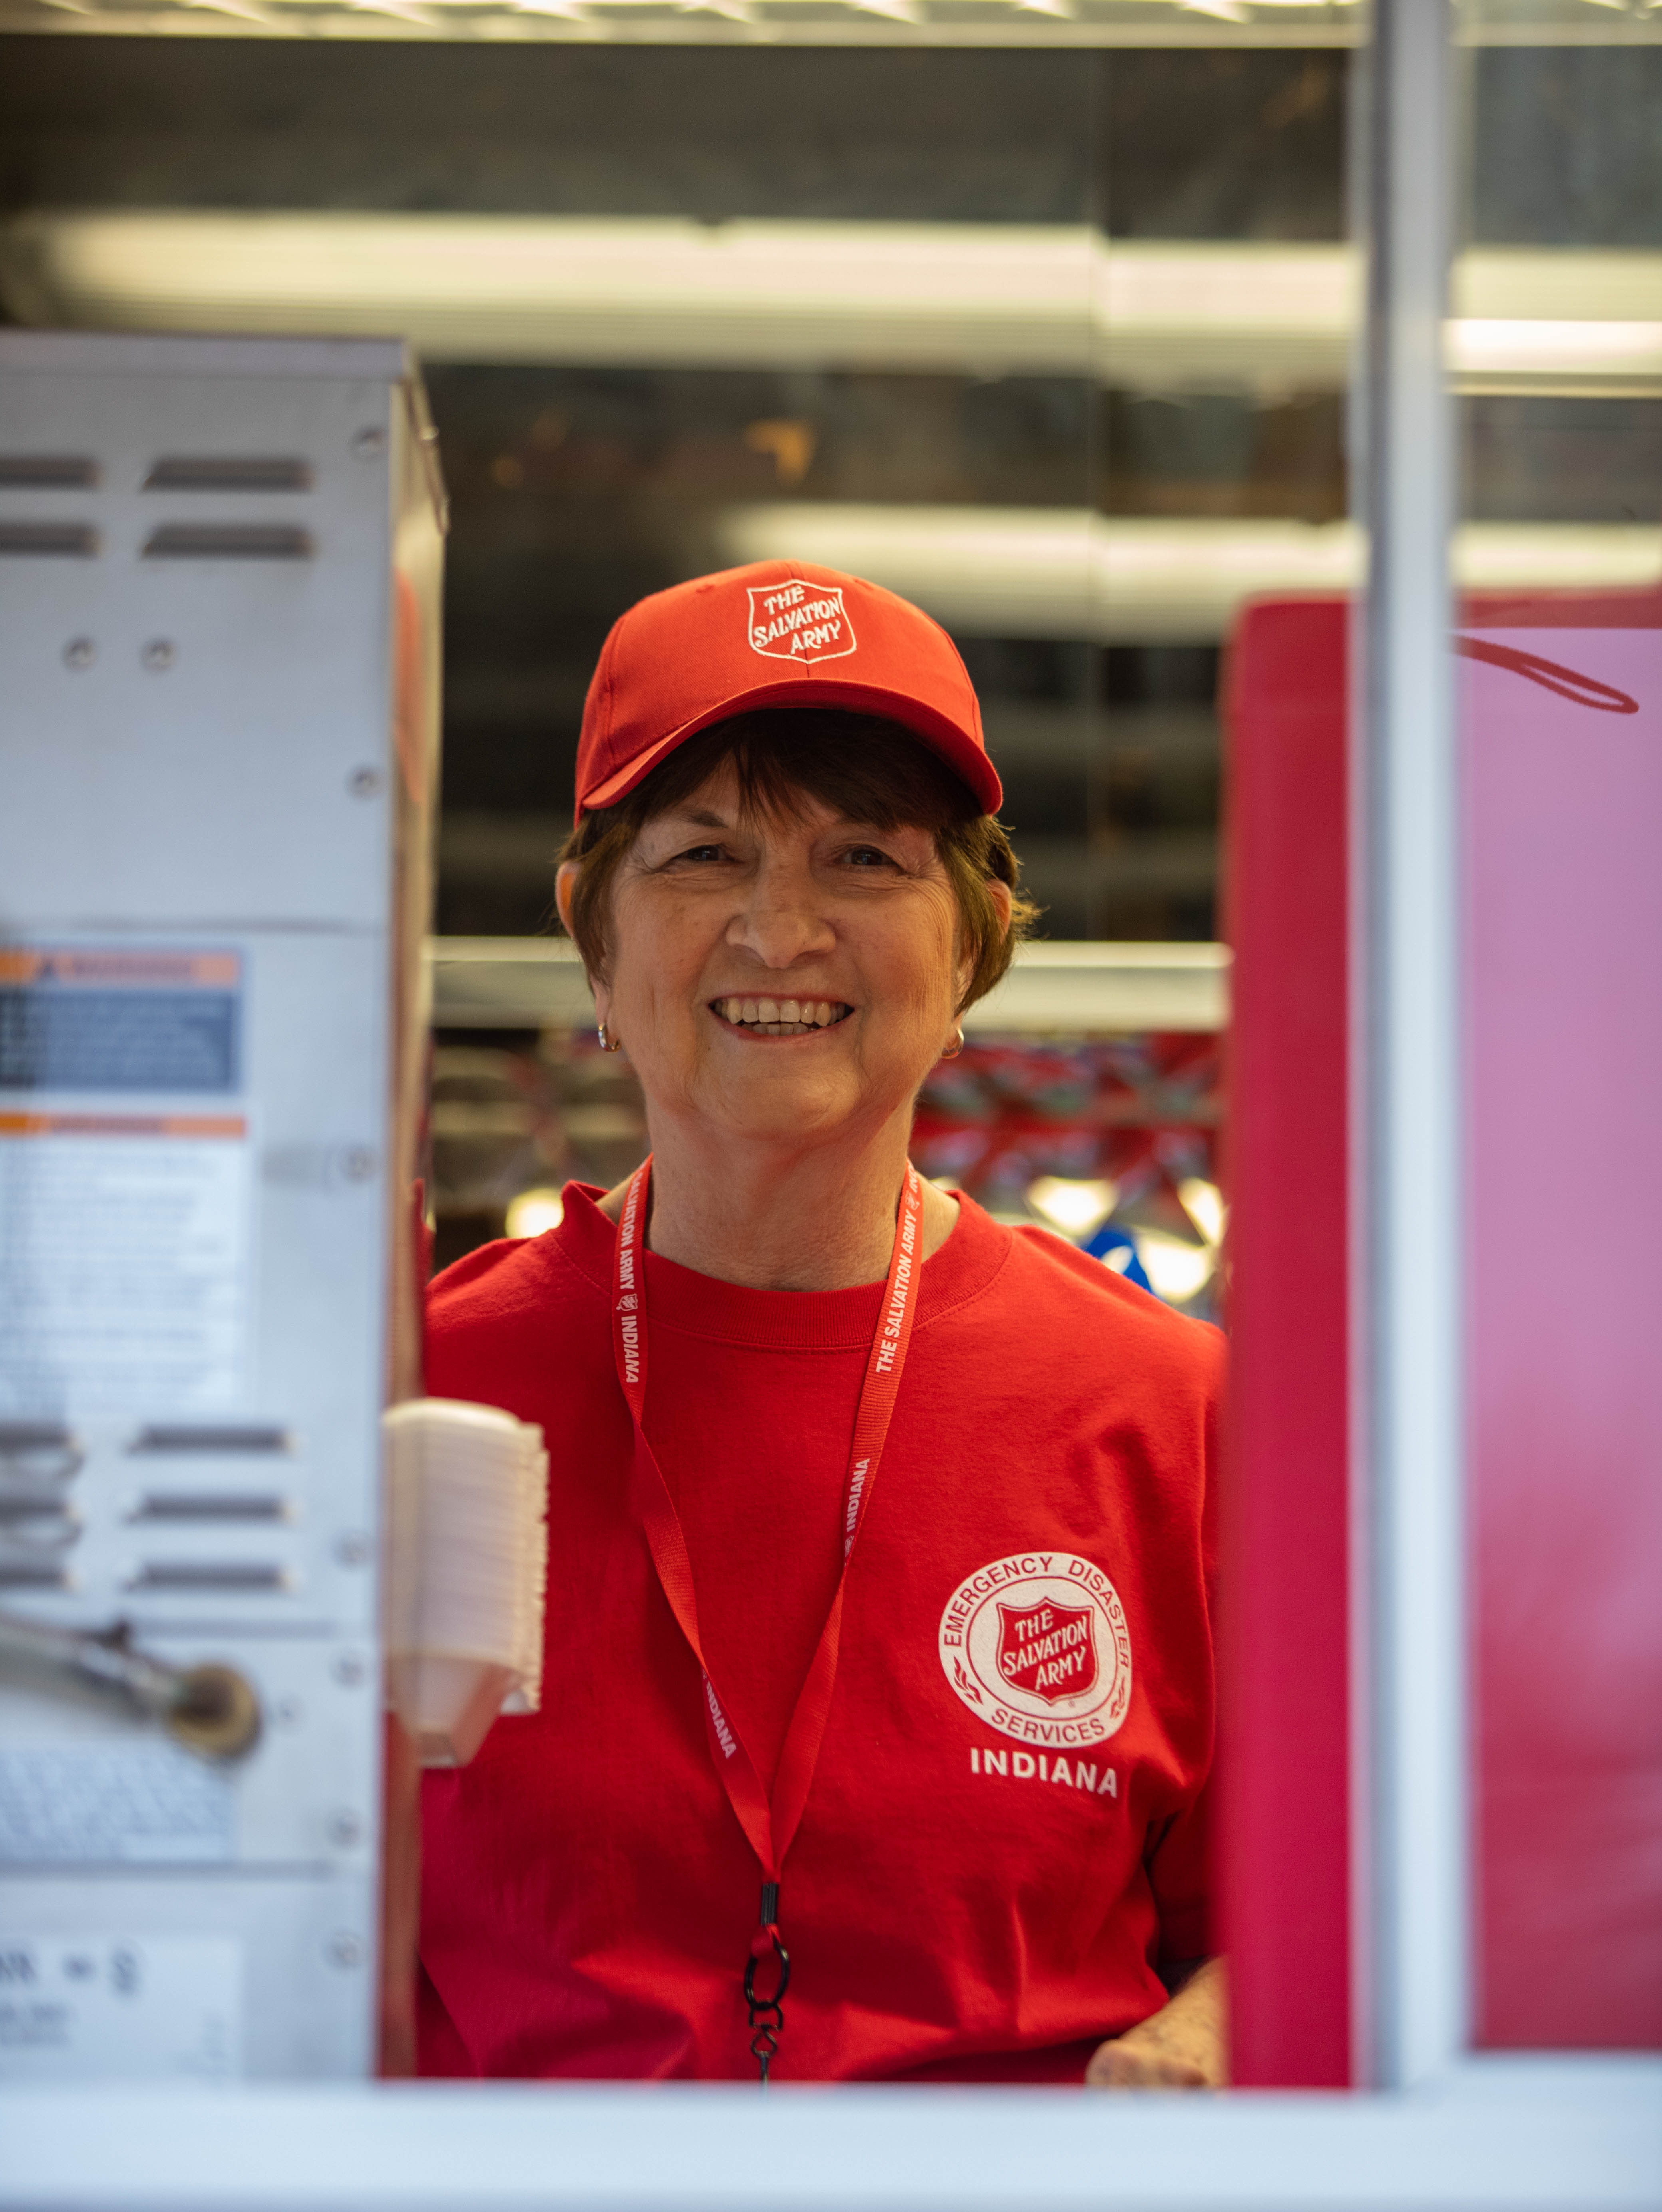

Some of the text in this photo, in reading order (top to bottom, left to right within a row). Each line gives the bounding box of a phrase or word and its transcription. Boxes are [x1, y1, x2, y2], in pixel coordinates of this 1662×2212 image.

[753, 596, 841, 647] SALVATION
[763, 585, 805, 615] THE
[790, 619, 841, 655] ARMY
[901, 1209, 916, 1256] ARMY
[620, 1249, 634, 1289] ARMY
[884, 1254, 912, 1338] SALVATION
[621, 1315, 640, 1383] INDIANA
[876, 1339, 897, 1373] THE
[847, 1458, 870, 1532] INDIANA
[944, 1556, 1129, 1668] EMERGENCY DISASTER
[1014, 1608, 1054, 1642] THE
[1003, 1615, 1088, 1676] SALVATION
[1035, 1645, 1086, 1691] ARMY
[706, 1681, 737, 1759] INDIANA
[991, 1708, 1105, 1743] SERVICES
[970, 1747, 1117, 1798] INDIANA
